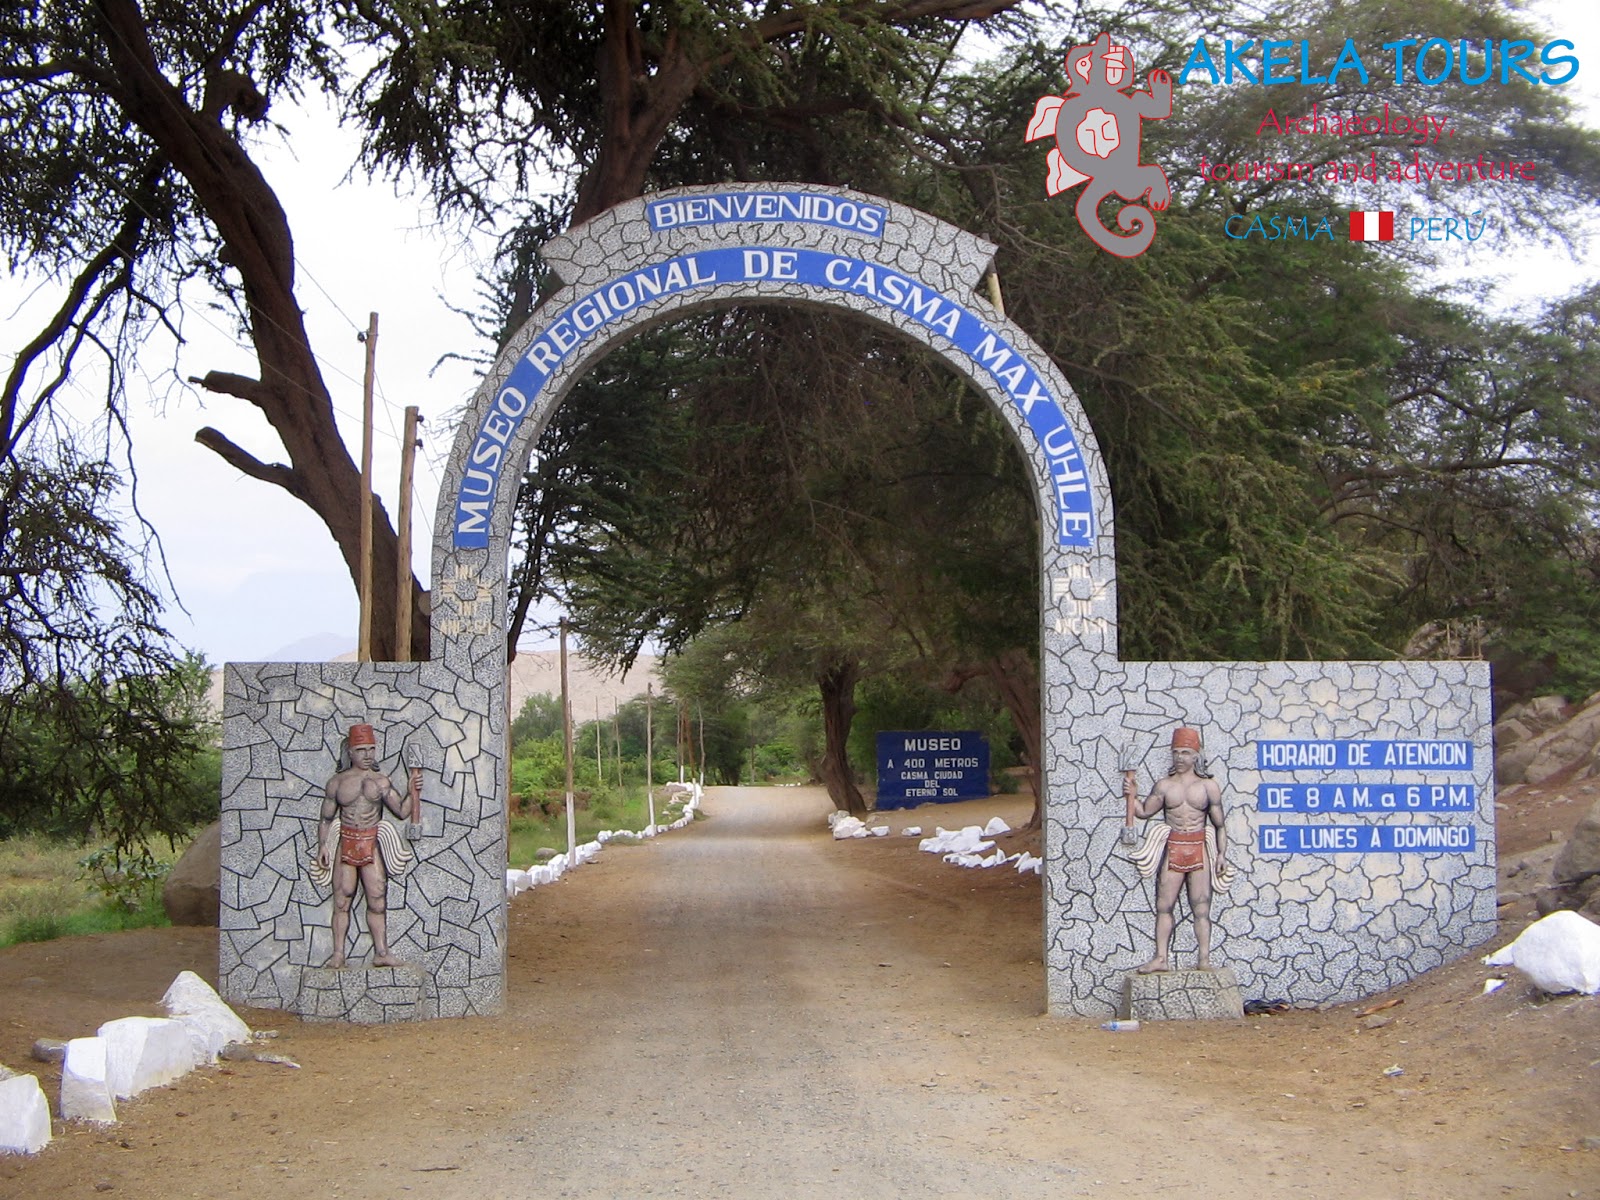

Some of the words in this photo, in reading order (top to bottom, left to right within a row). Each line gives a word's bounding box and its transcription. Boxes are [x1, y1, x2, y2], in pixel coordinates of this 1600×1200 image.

[653, 195, 882, 232] BIENVENIDOS
[457, 386, 527, 534] MUSEO
[526, 256, 716, 376] REGIONAL
[743, 250, 798, 280] DE
[824, 258, 963, 339] CASMA
[904, 738, 961, 751] MUSEO
[887, 759, 894, 769] A
[904, 758, 926, 769] 400
[934, 757, 979, 768] METROS
[1262, 743, 1337, 766] HORARIO
[1347, 743, 1372, 766] DE
[1383, 742, 1467, 766] ATENCION
[900, 771, 929, 780] CASMA
[934, 770, 963, 780] CIUDAD
[924, 779, 941, 788] DEL
[905, 788, 938, 797] ETERNO
[942, 787, 959, 797] SOL
[1266, 787, 1294, 809] DE
[1306, 787, 1320, 808] 8
[1381, 791, 1396, 808] a
[1406, 786, 1421, 807] 6
[1431, 786, 1471, 807] P.M.
[1264, 828, 1287, 850] DE
[1300, 827, 1358, 849] LUNES
[1370, 827, 1382, 848] A
[1393, 825, 1470, 848] DOMINGO
